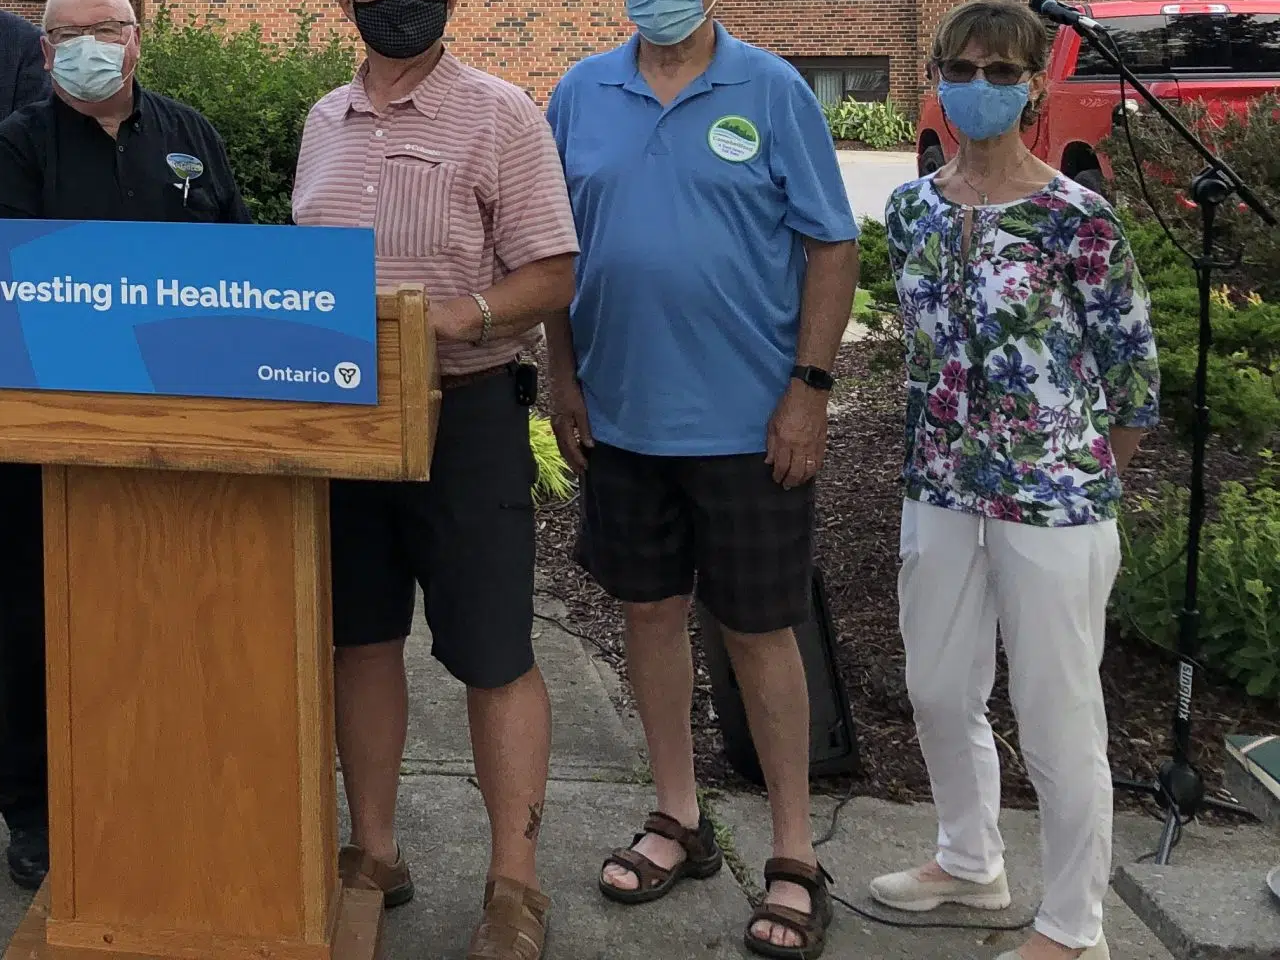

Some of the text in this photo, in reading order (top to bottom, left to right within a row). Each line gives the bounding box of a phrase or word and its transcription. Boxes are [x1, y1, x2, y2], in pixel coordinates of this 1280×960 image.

[120, 277, 148, 305] in
[156, 279, 336, 313] Healthcare
[257, 365, 330, 384] Ontario
